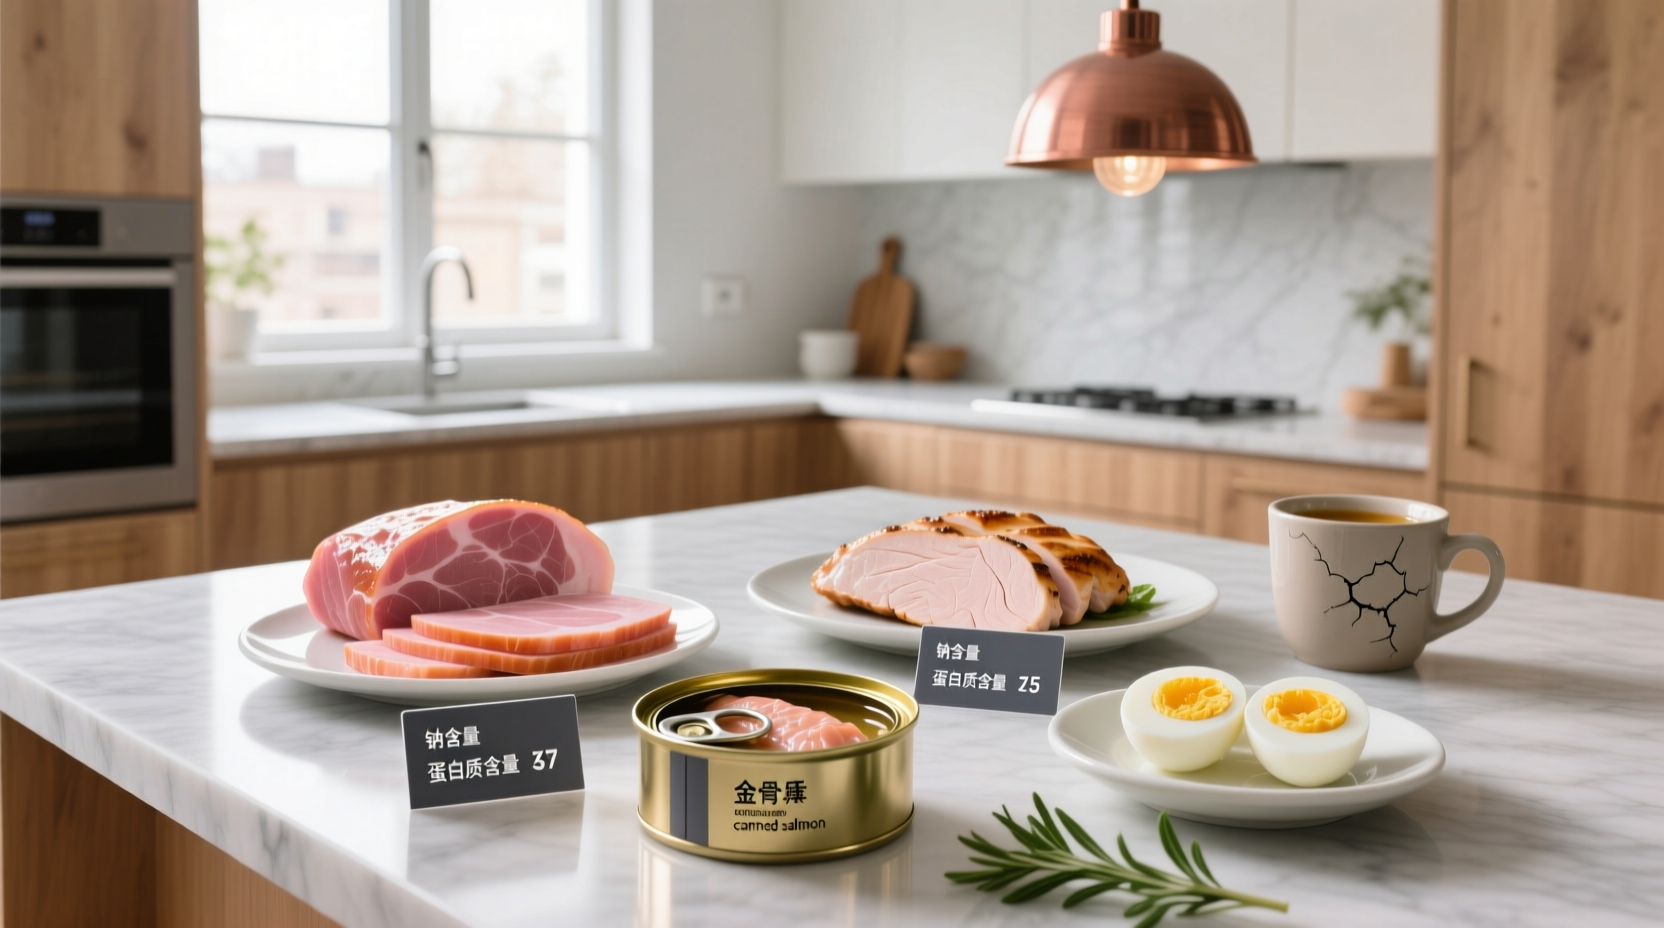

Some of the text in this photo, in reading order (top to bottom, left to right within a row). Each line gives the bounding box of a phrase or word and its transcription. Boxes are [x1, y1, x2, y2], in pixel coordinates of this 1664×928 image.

[932, 669, 1007, 692] 蛋白质含量
[425, 725, 481, 750] 钠含量
[427, 748, 558, 783] 蛋白质含量 37
